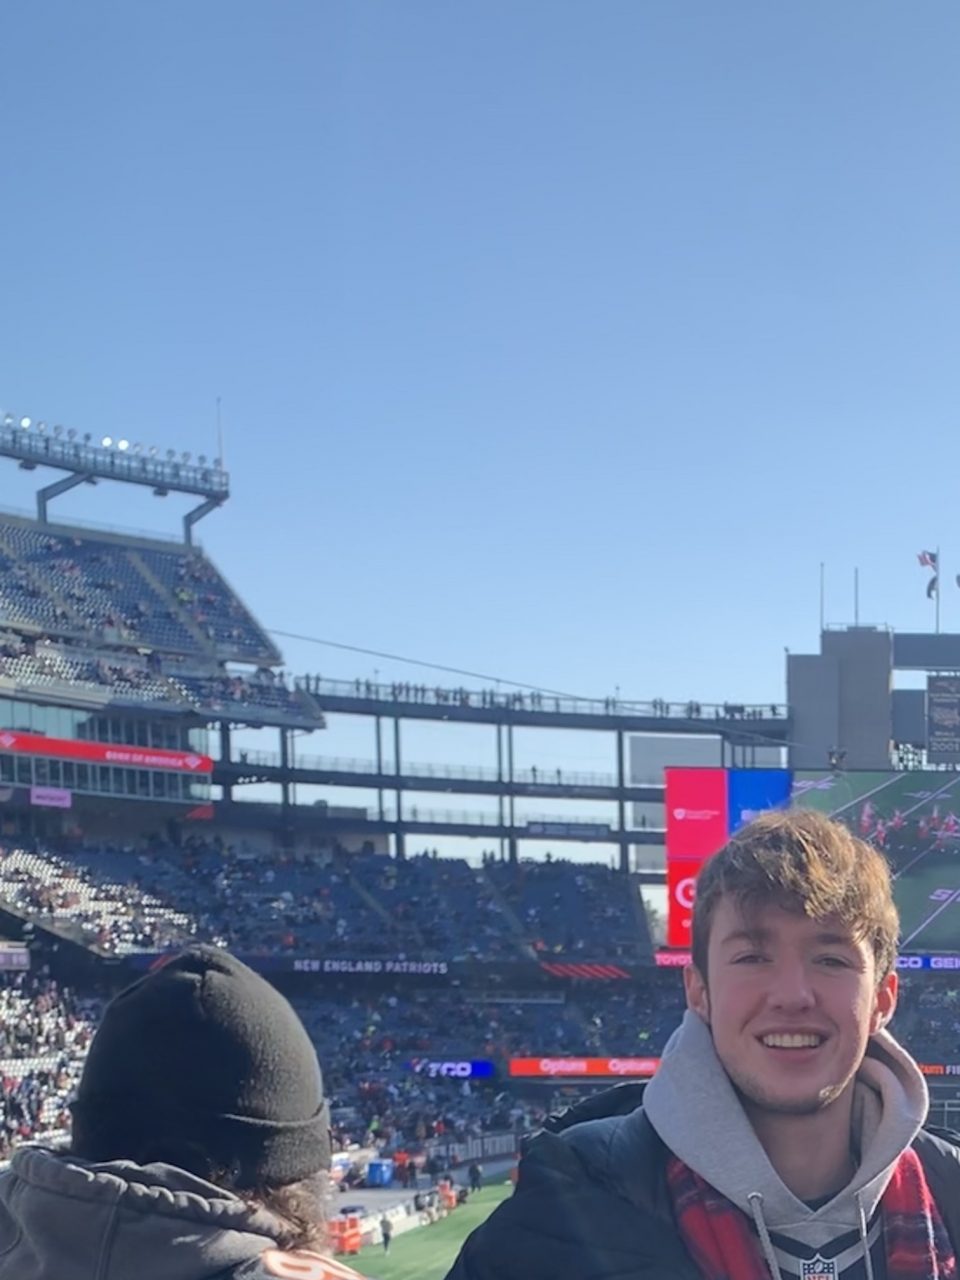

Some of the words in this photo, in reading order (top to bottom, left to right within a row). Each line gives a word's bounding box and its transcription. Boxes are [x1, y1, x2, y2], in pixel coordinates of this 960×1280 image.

[294, 959, 320, 972] NEW
[323, 960, 382, 973] ENGLAND
[385, 961, 448, 974] PATRIOTS
[655, 953, 693, 966] TOYO
